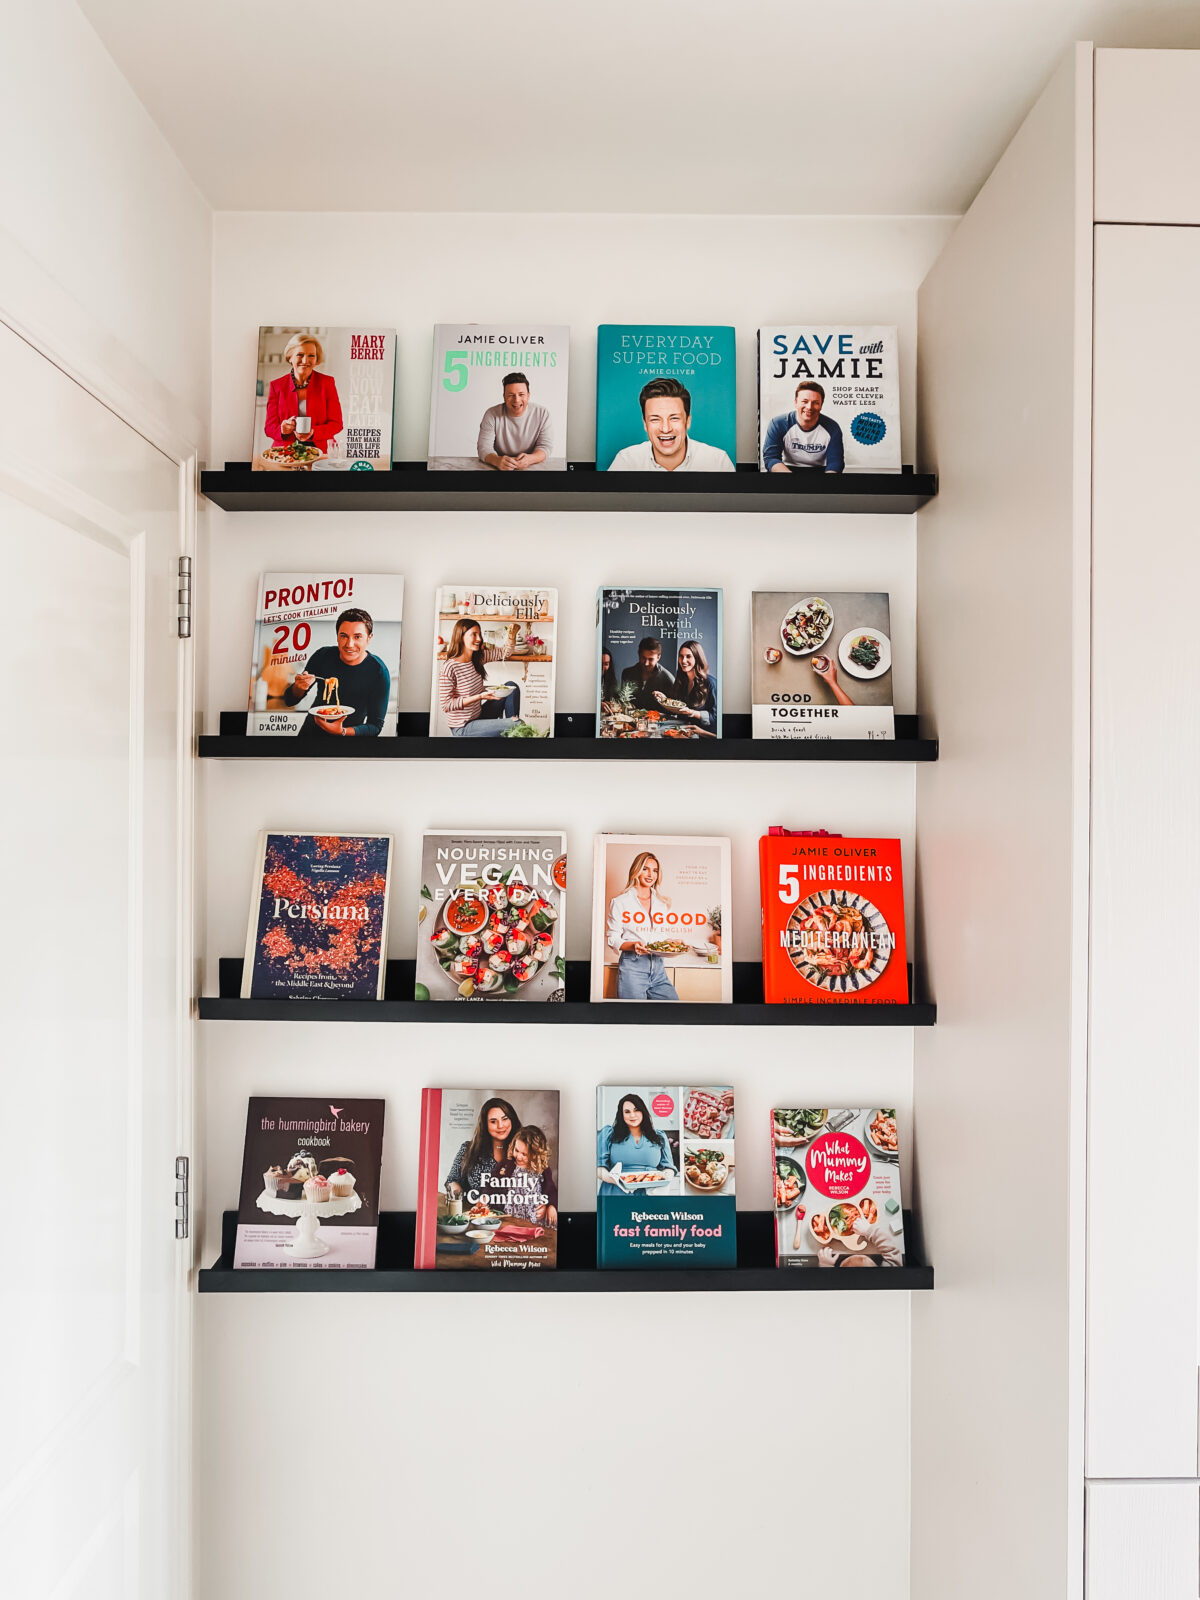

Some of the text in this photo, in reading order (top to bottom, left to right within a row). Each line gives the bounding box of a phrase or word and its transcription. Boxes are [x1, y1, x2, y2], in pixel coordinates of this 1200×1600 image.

[351, 335, 385, 348] MARY
[458, 336, 544, 344] JAMIE OLIVER
[621, 335, 714, 348] EVERYDAY
[773, 334, 884, 355] SAVE with
[351, 349, 384, 360] BERRY
[613, 352, 721, 365] SUPER FOOD
[442, 350, 557, 392] 5 INGREDIENTS
[773, 358, 883, 378] JAMIE
[348, 394, 383, 414] EAT
[346, 450, 380, 458] EASIER
[264, 578, 353, 610] PRONTO!
[474, 594, 545, 611] Deliciously
[263, 615, 281, 624] LET'S
[283, 611, 301, 620] COOK
[303, 608, 328, 617] ITALIAN
[516, 608, 539, 620] Ella
[629, 603, 696, 618] Deliciously
[641, 616, 692, 629] Ella with
[272, 622, 311, 655] 20
[660, 628, 703, 639] Friends
[271, 653, 307, 666] minutes
[771, 694, 811, 702] GOOD
[269, 715, 288, 723] GINO
[771, 708, 839, 717] TOGETHER
[259, 723, 297, 731] D'ACAMPO
[437, 848, 554, 861] NOURISHING
[792, 848, 877, 857] JAMIE OLIVER
[436, 863, 553, 886] VEGAN
[779, 864, 892, 904] 5 INGREDIENTS
[435, 889, 554, 901] EVERY DAY
[272, 898, 370, 921] Persiana
[622, 911, 707, 925] SO GOOD
[780, 930, 896, 949] MEDITERRANEAN
[294, 973, 317, 981] Recipes
[261, 1117, 370, 1134] the hummingbird bakery
[298, 1136, 330, 1147] cookbook
[825, 1140, 850, 1156] What
[811, 1149, 867, 1173] Mummy
[480, 1173, 539, 1191] Family
[825, 1168, 853, 1183] Makes
[466, 1190, 549, 1205] Comforts
[631, 1212, 704, 1222] Rebecca Wilson
[613, 1224, 722, 1240] fast family food
[485, 1245, 548, 1254] Rebecca Wilson
[503, 1259, 527, 1269] Mummy
